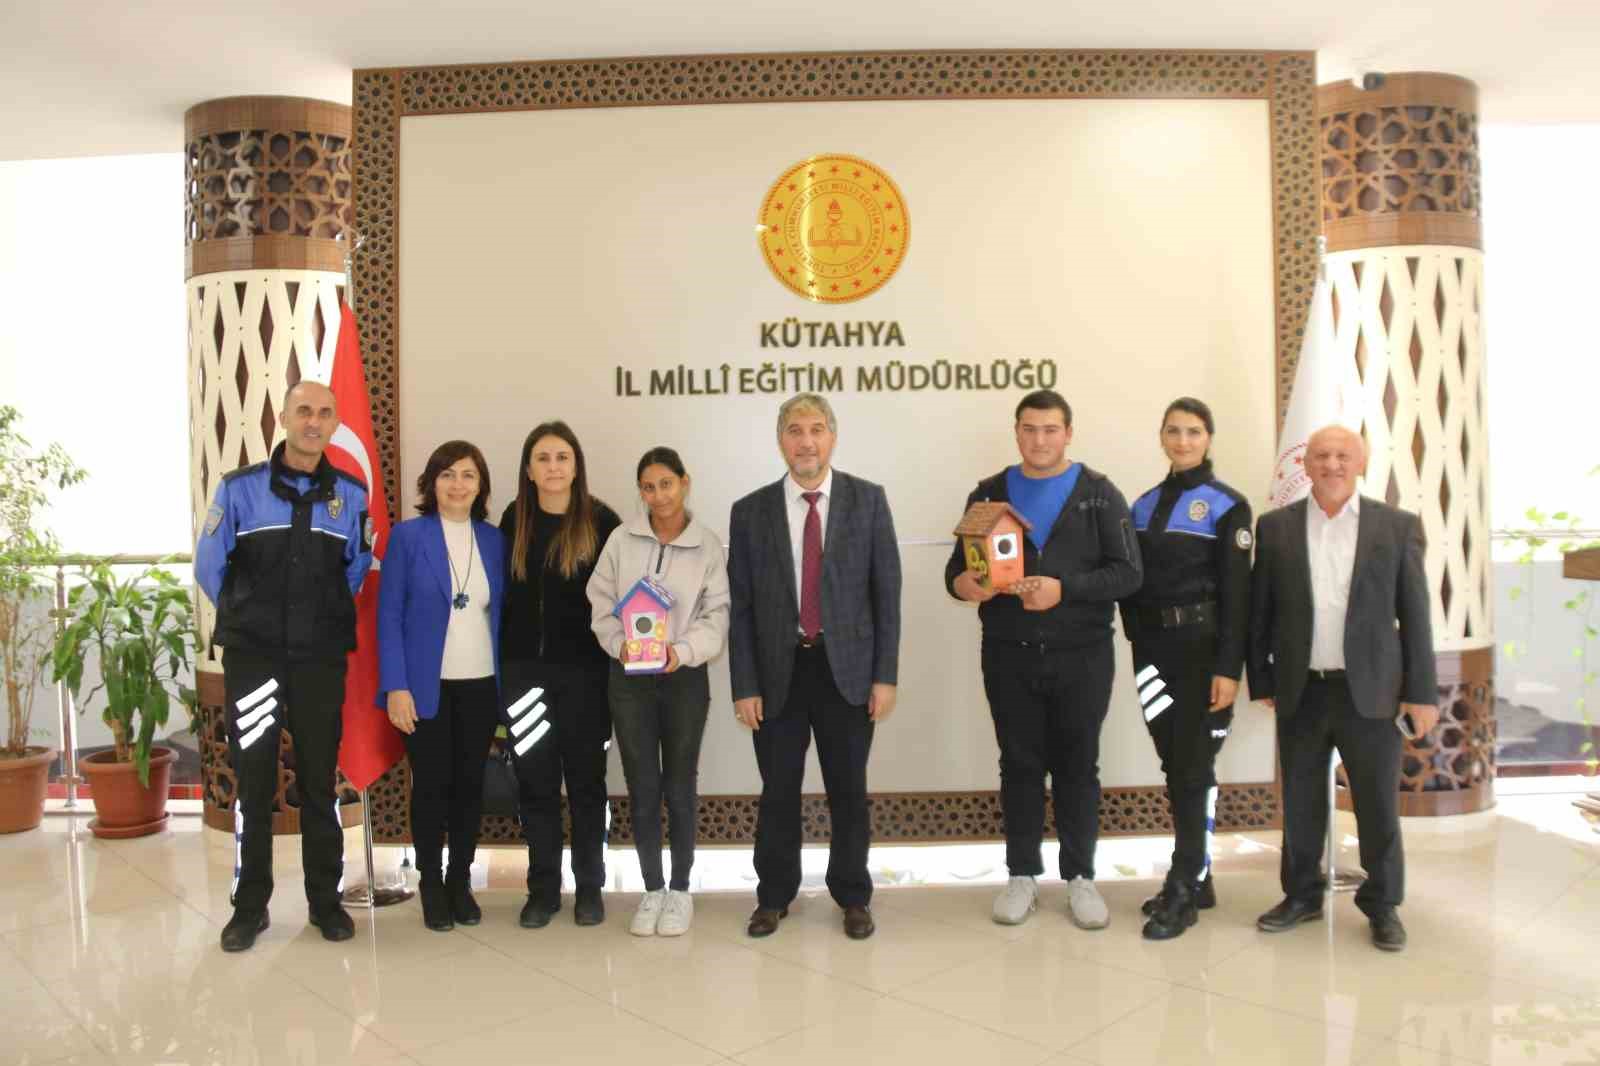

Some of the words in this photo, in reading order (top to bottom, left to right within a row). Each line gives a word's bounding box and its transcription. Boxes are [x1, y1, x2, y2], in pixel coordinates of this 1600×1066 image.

[760, 317, 906, 348] KÜTAHYA
[615, 366, 641, 396] İL
[738, 362, 844, 393] EĞİTİM
[856, 359, 1058, 392] MÜDÜRLÜĞÜ
